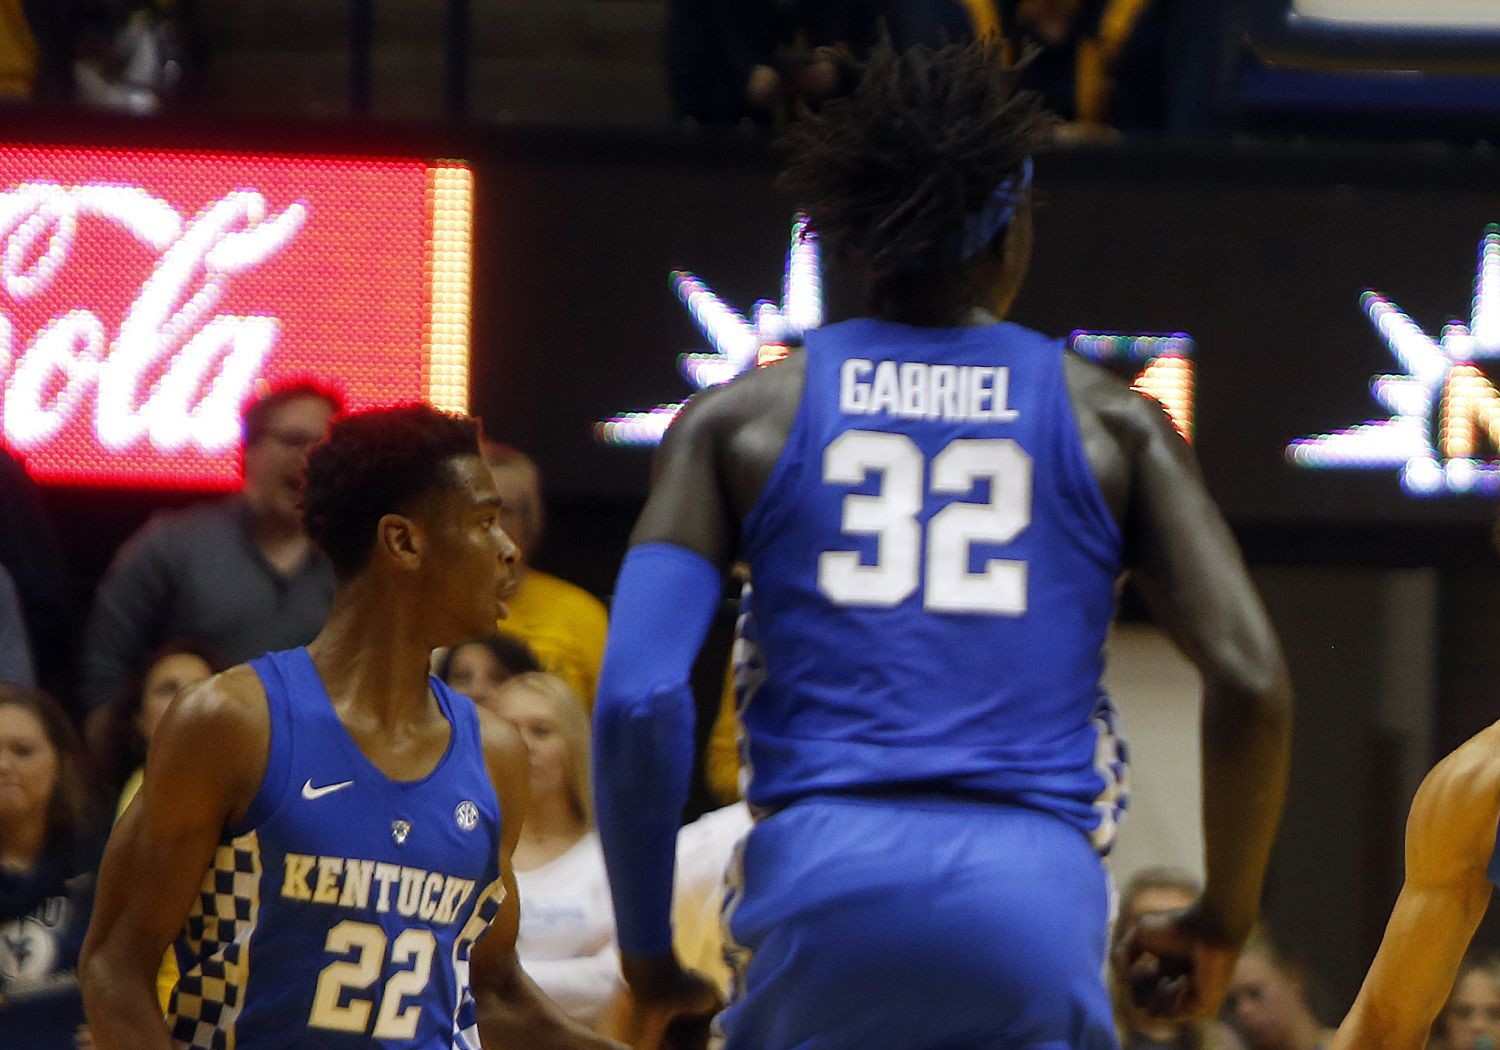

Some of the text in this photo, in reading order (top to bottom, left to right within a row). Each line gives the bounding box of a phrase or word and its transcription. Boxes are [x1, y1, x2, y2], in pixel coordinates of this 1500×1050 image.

[840, 358, 1020, 423] GABRIEL
[817, 428, 1034, 617] 32
[307, 919, 438, 1040] 22
